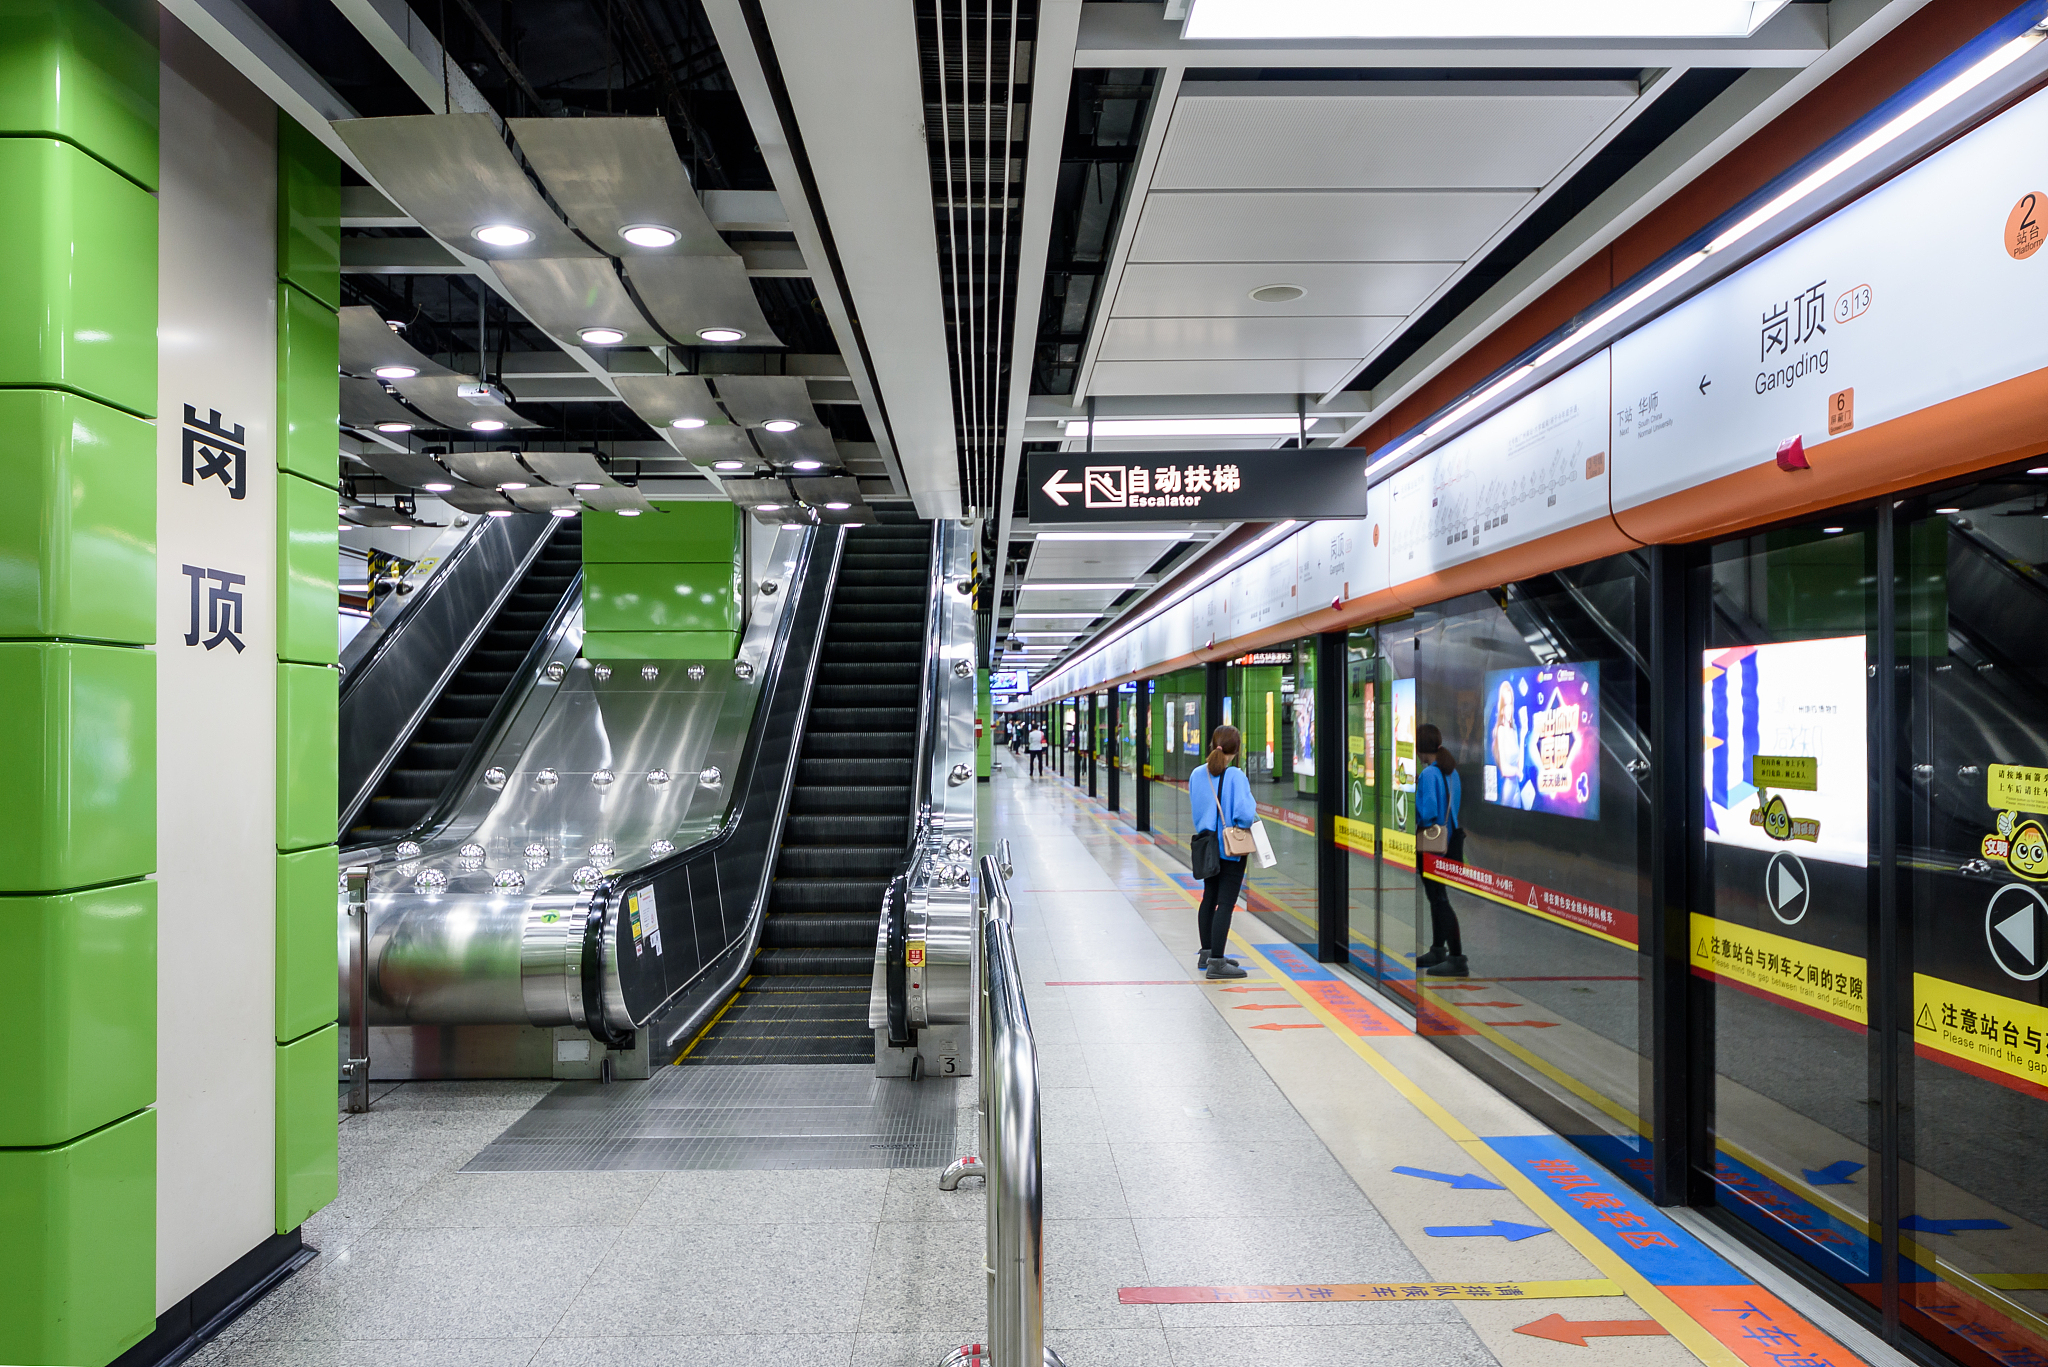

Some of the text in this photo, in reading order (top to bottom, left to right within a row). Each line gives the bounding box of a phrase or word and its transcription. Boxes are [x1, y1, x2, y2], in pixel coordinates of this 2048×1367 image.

[2019, 193, 2037, 231] 2
[2013, 238, 2044, 258] Platform
[2016, 224, 2040, 246] 站台
[1841, 288, 1871, 317] 3 13
[1760, 278, 1827, 364] 岗顶
[1754, 348, 1830, 396] Gangding
[1616, 406, 1633, 427] 下站
[1638, 390, 1659, 417] 华师
[1837, 393, 1846, 412] 6
[1127, 464, 1241, 494] 自动扶梯
[1128, 494, 1201, 508] Escalator
[181, 401, 248, 656] 岗顶
[1985, 838, 2009, 857] 文明
[1710, 936, 1864, 1000] 注意站台与列车之间的空隙
[1711, 955, 1864, 1015] Please mind the gap between train and platform.
[1941, 1002, 2048, 1058] 注意站台与
[944, 1057, 956, 1074] 3
[1943, 1029, 2048, 1075] Please mind the gap
[1526, 1158, 1679, 1250] 排队候车区
